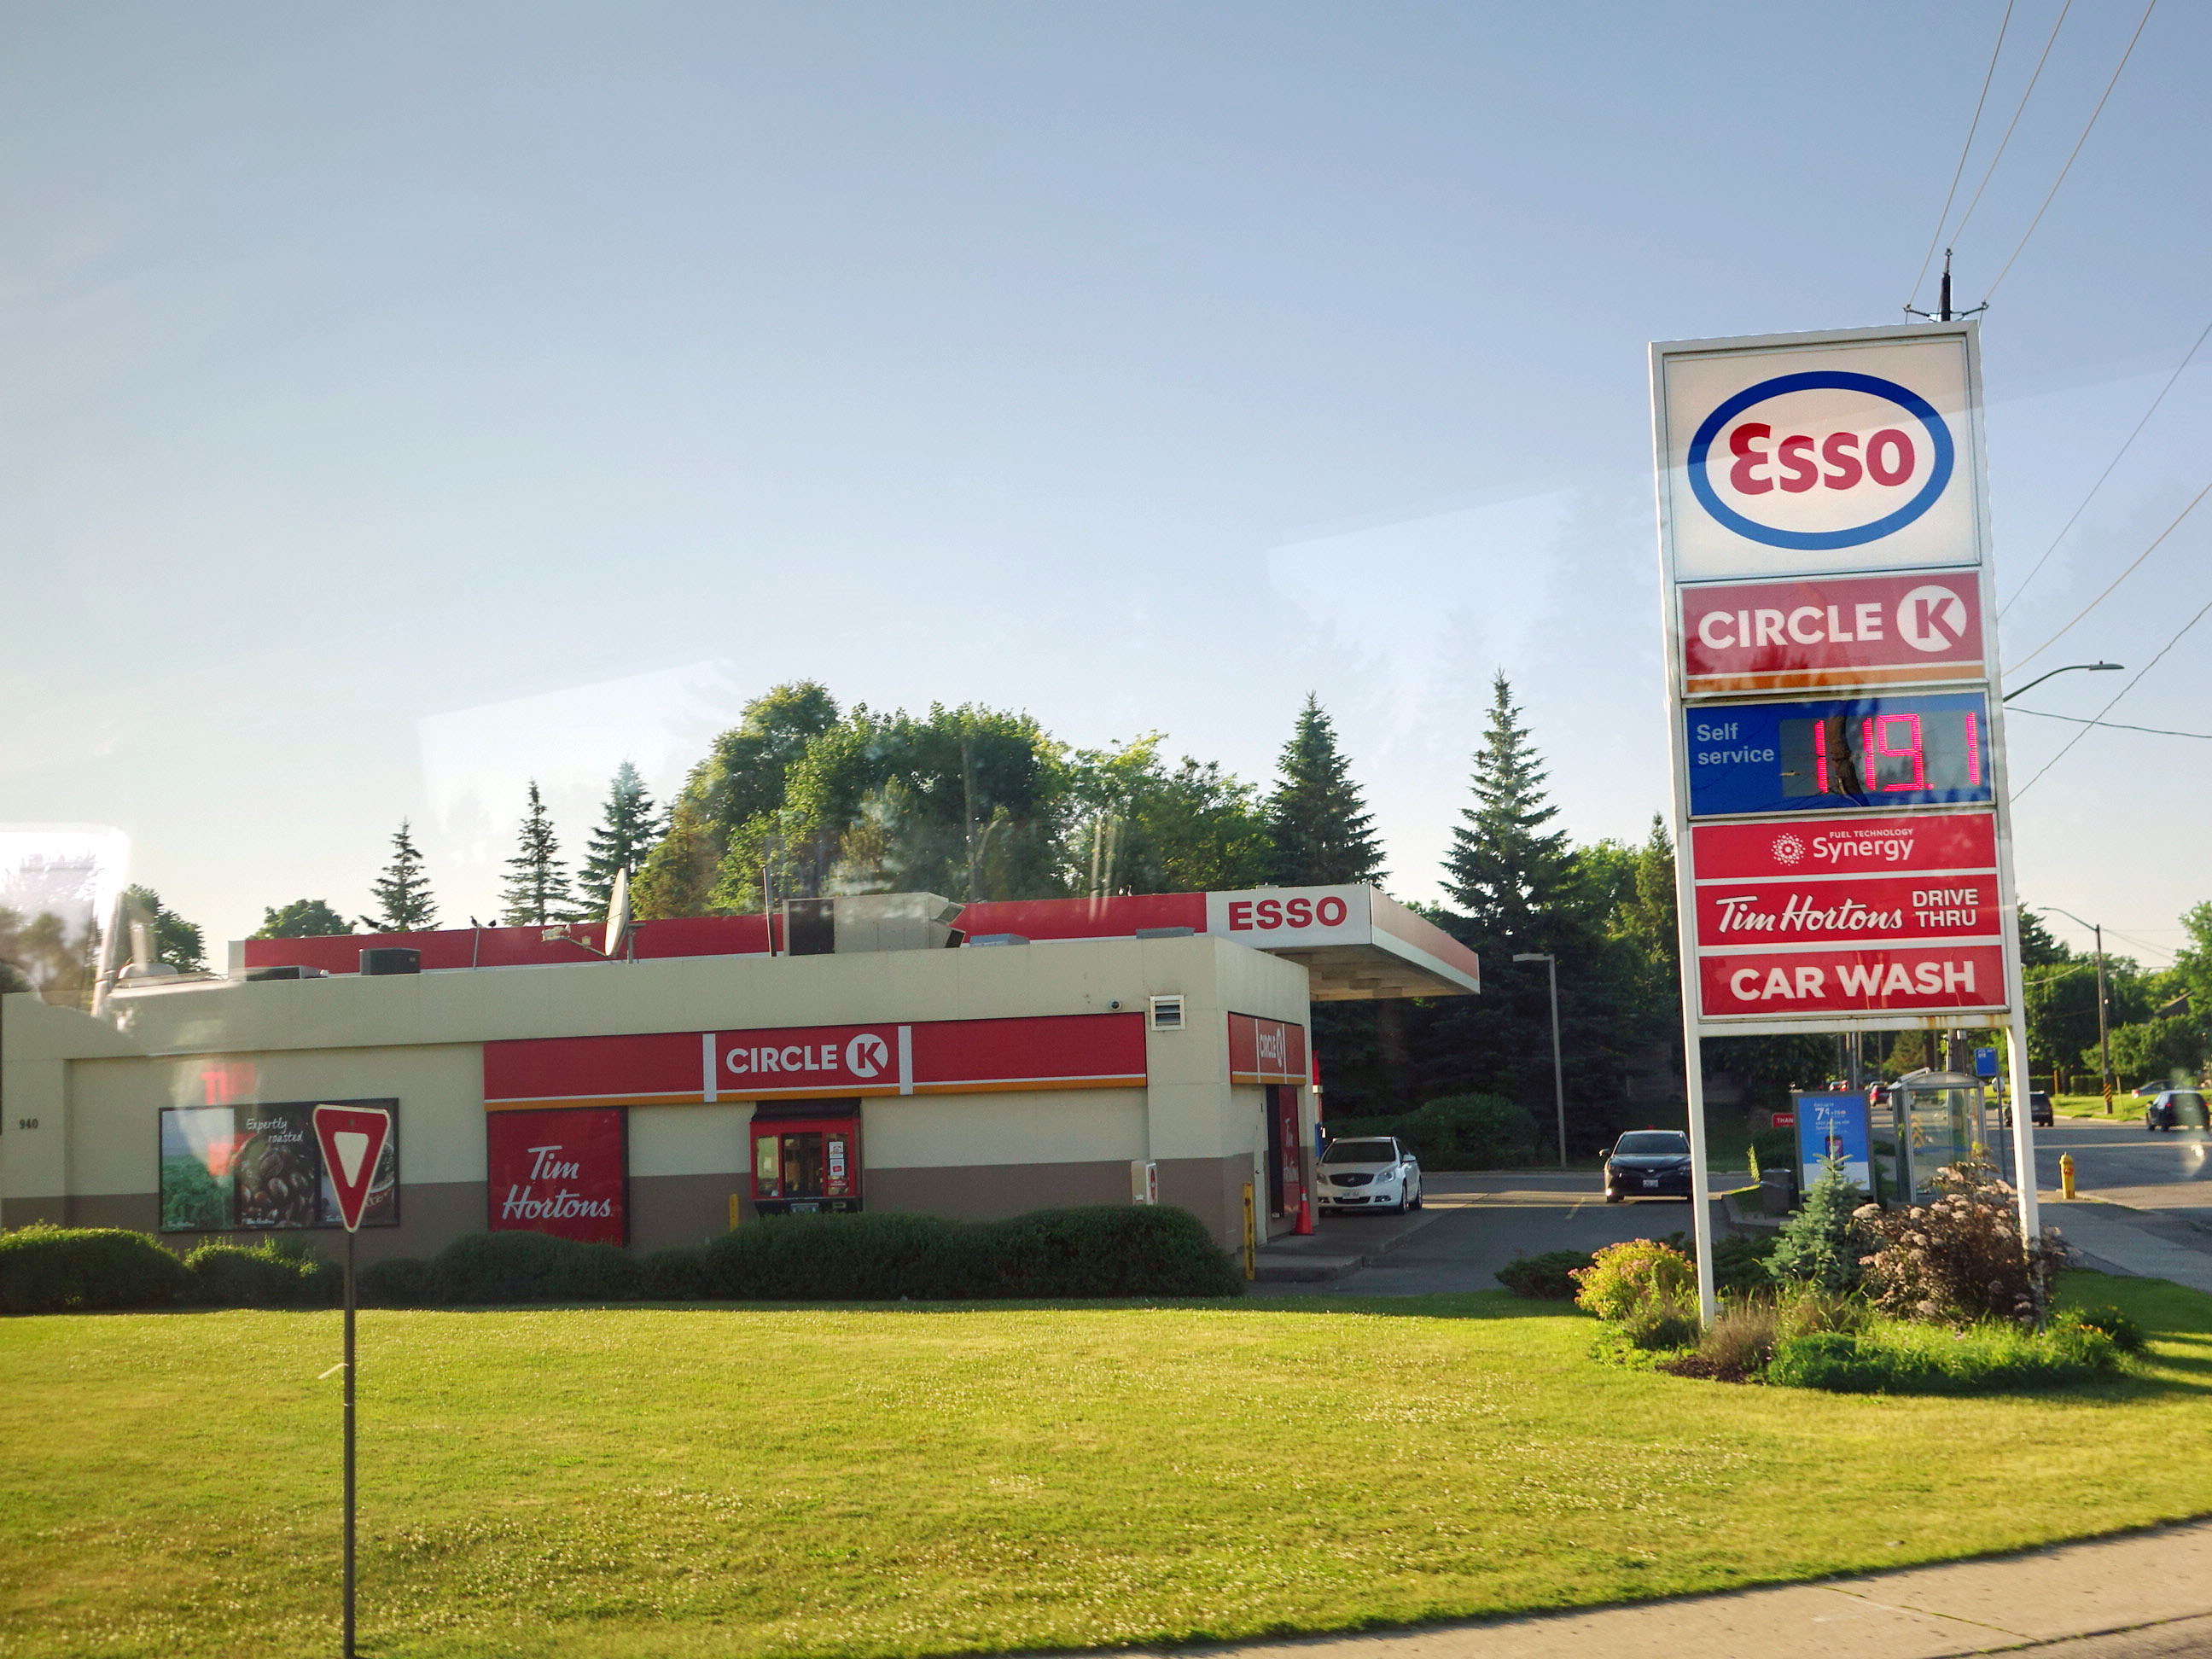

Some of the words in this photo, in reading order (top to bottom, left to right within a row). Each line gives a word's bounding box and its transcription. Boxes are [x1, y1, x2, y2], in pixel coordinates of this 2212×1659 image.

[1698, 602, 1883, 649] CIRCLE
[1907, 591, 1965, 649] K
[1697, 723, 1738, 741] Self
[1697, 744, 1774, 765] service
[1854, 829, 1913, 837] TECHNOLOGY
[1813, 837, 1914, 864] Synergy
[1912, 888, 1979, 908] DRIVE
[1228, 896, 1347, 931] ESSO
[1715, 895, 1776, 933] Tim
[1779, 893, 1903, 932] Hortons
[1918, 909, 1977, 928] THRU
[1730, 967, 1825, 1001] CAR
[1835, 961, 1976, 998] WASH
[726, 1045, 838, 1074] CIRCLE
[852, 1038, 887, 1077] K
[19, 1118, 39, 1129] 940
[246, 1117, 288, 1134] Expertly
[268, 1131, 304, 1143] roasted
[527, 1145, 579, 1180] Tim
[502, 1185, 611, 1220] Hortons
